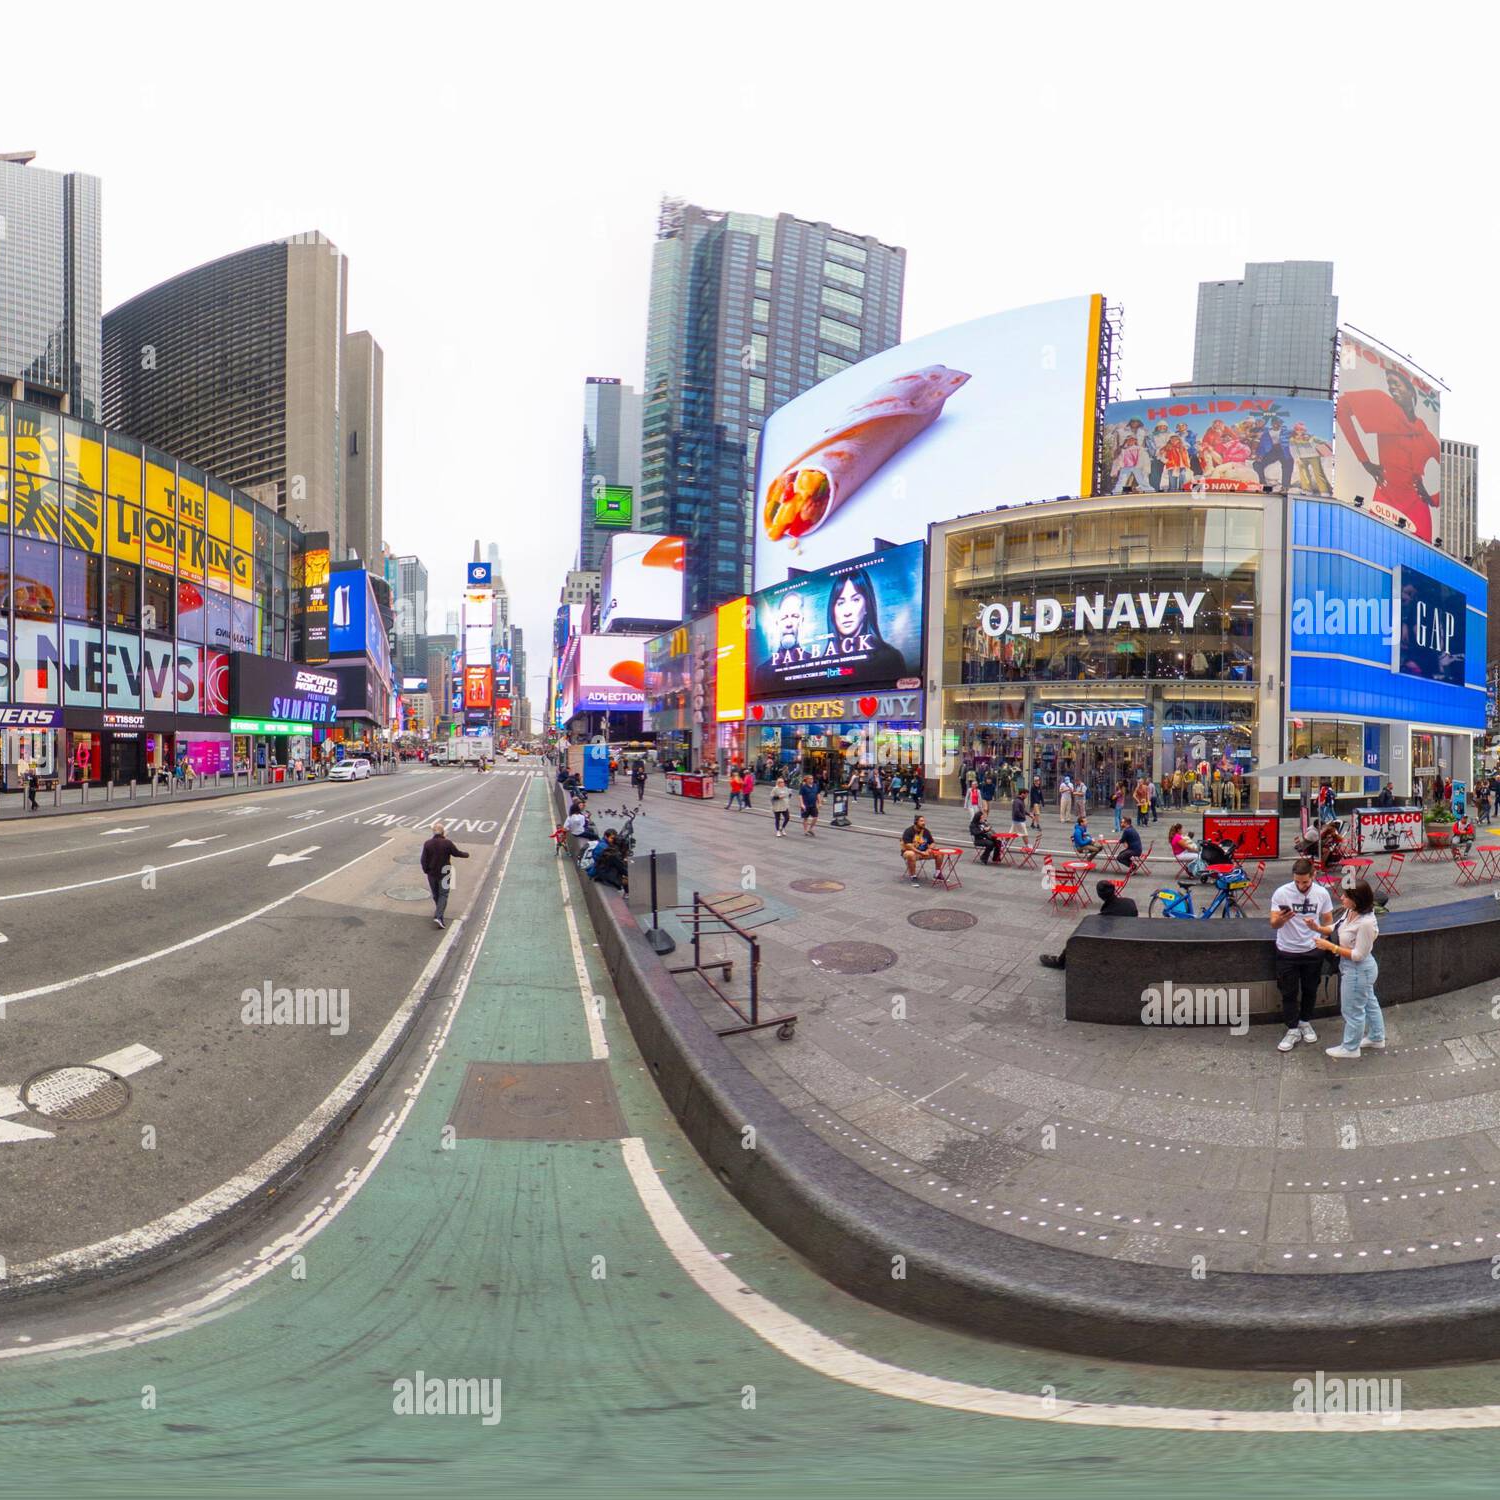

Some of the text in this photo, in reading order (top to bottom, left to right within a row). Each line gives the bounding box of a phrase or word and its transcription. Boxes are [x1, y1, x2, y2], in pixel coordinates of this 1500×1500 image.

[1147, 399, 1274, 421] HOLIDAY
[1211, 482, 1240, 490] NAVY
[164, 487, 204, 520] THE
[1375, 503, 1414, 530] OLD NY
[117, 494, 247, 581] LION KING
[147, 558, 174, 571] ENTRANCE
[981, 591, 1206, 637] OLD NAVY
[1416, 600, 1455, 656] GAP
[771, 633, 874, 666] PAYBACK
[37, 635, 195, 701] NEWS
[295, 681, 323, 694] WORLD
[116, 716, 145, 724] TISSOT
[272, 697, 337, 722] SUMMER 2
[790, 700, 845, 719] GIFTS
[1043, 710, 1134, 728] OLD NAVY
[1367, 753, 1378, 765] GAP
